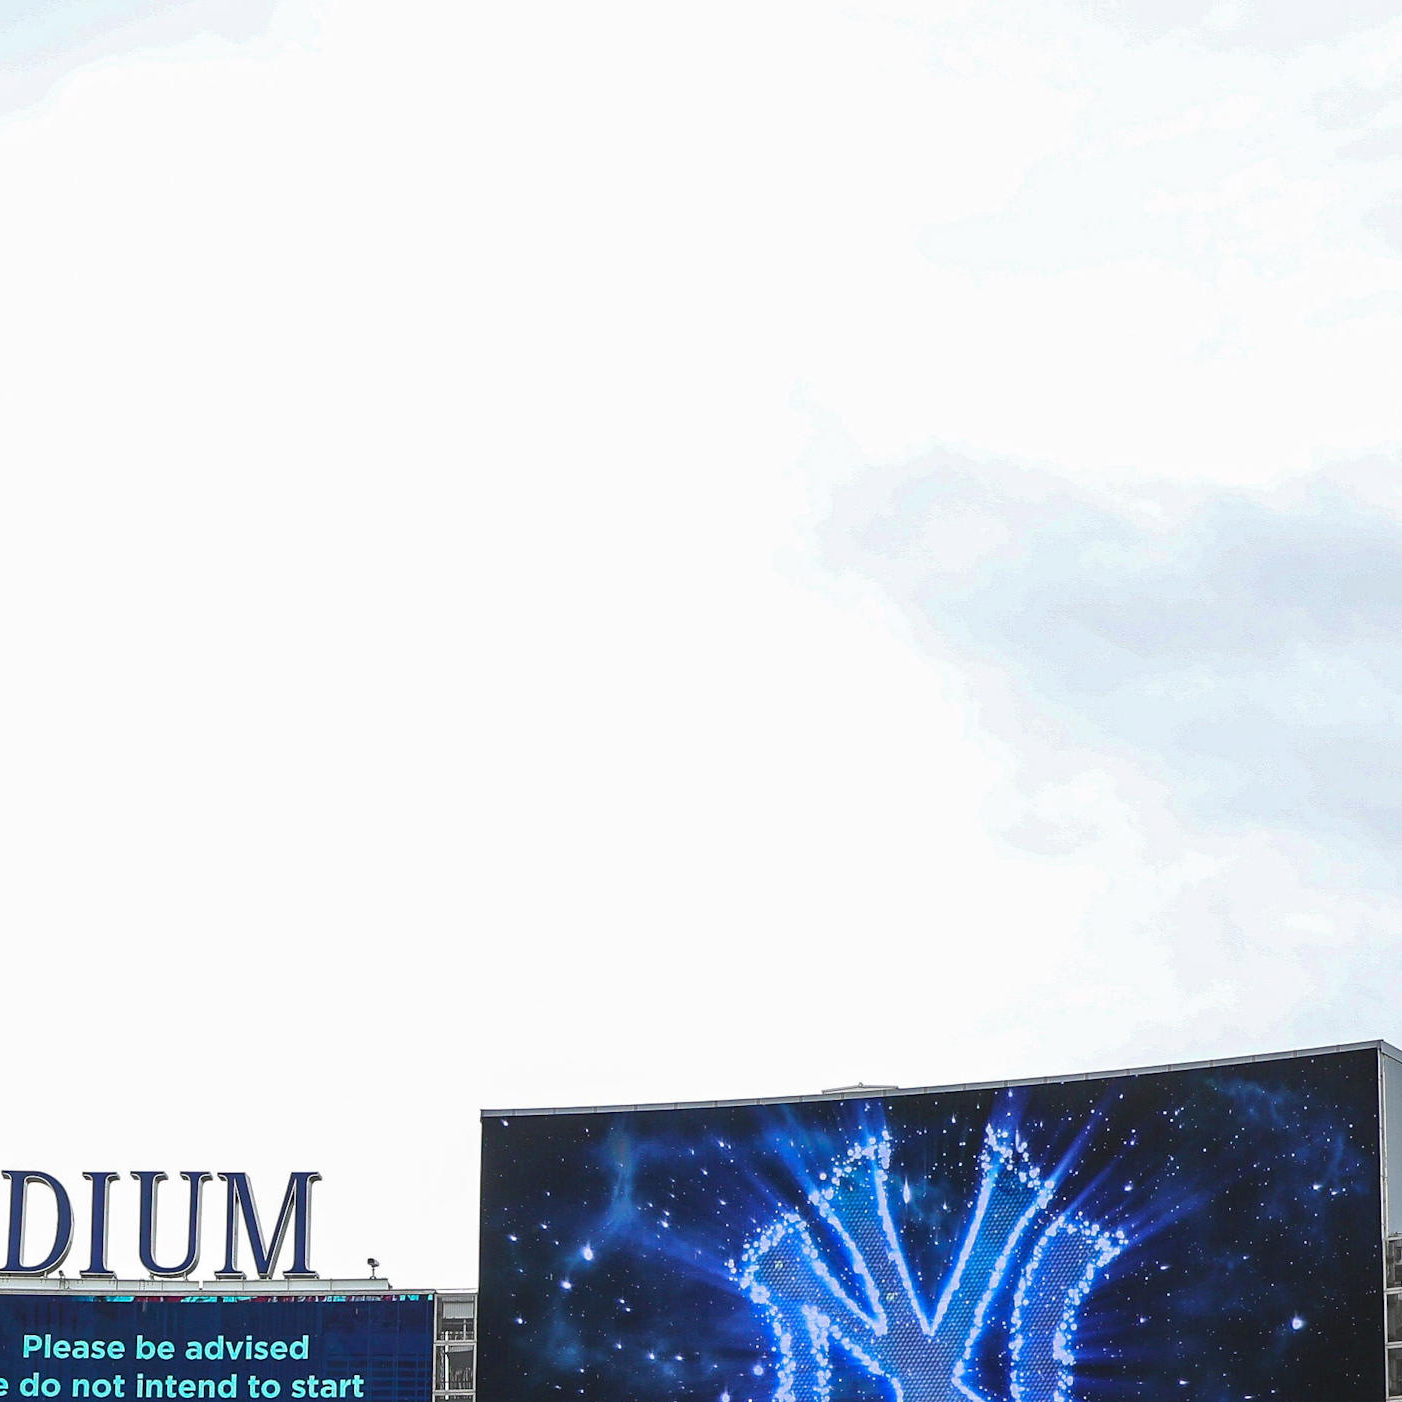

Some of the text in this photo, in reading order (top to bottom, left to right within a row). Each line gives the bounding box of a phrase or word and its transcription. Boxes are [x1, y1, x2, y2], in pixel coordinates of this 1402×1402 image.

[22, 1333, 309, 1361] Please be advised
[20, 1373, 61, 1399] do
[72, 1375, 125, 1399] not
[136, 1372, 238, 1399] intend
[248, 1376, 281, 1399] to
[290, 1375, 365, 1399] start
